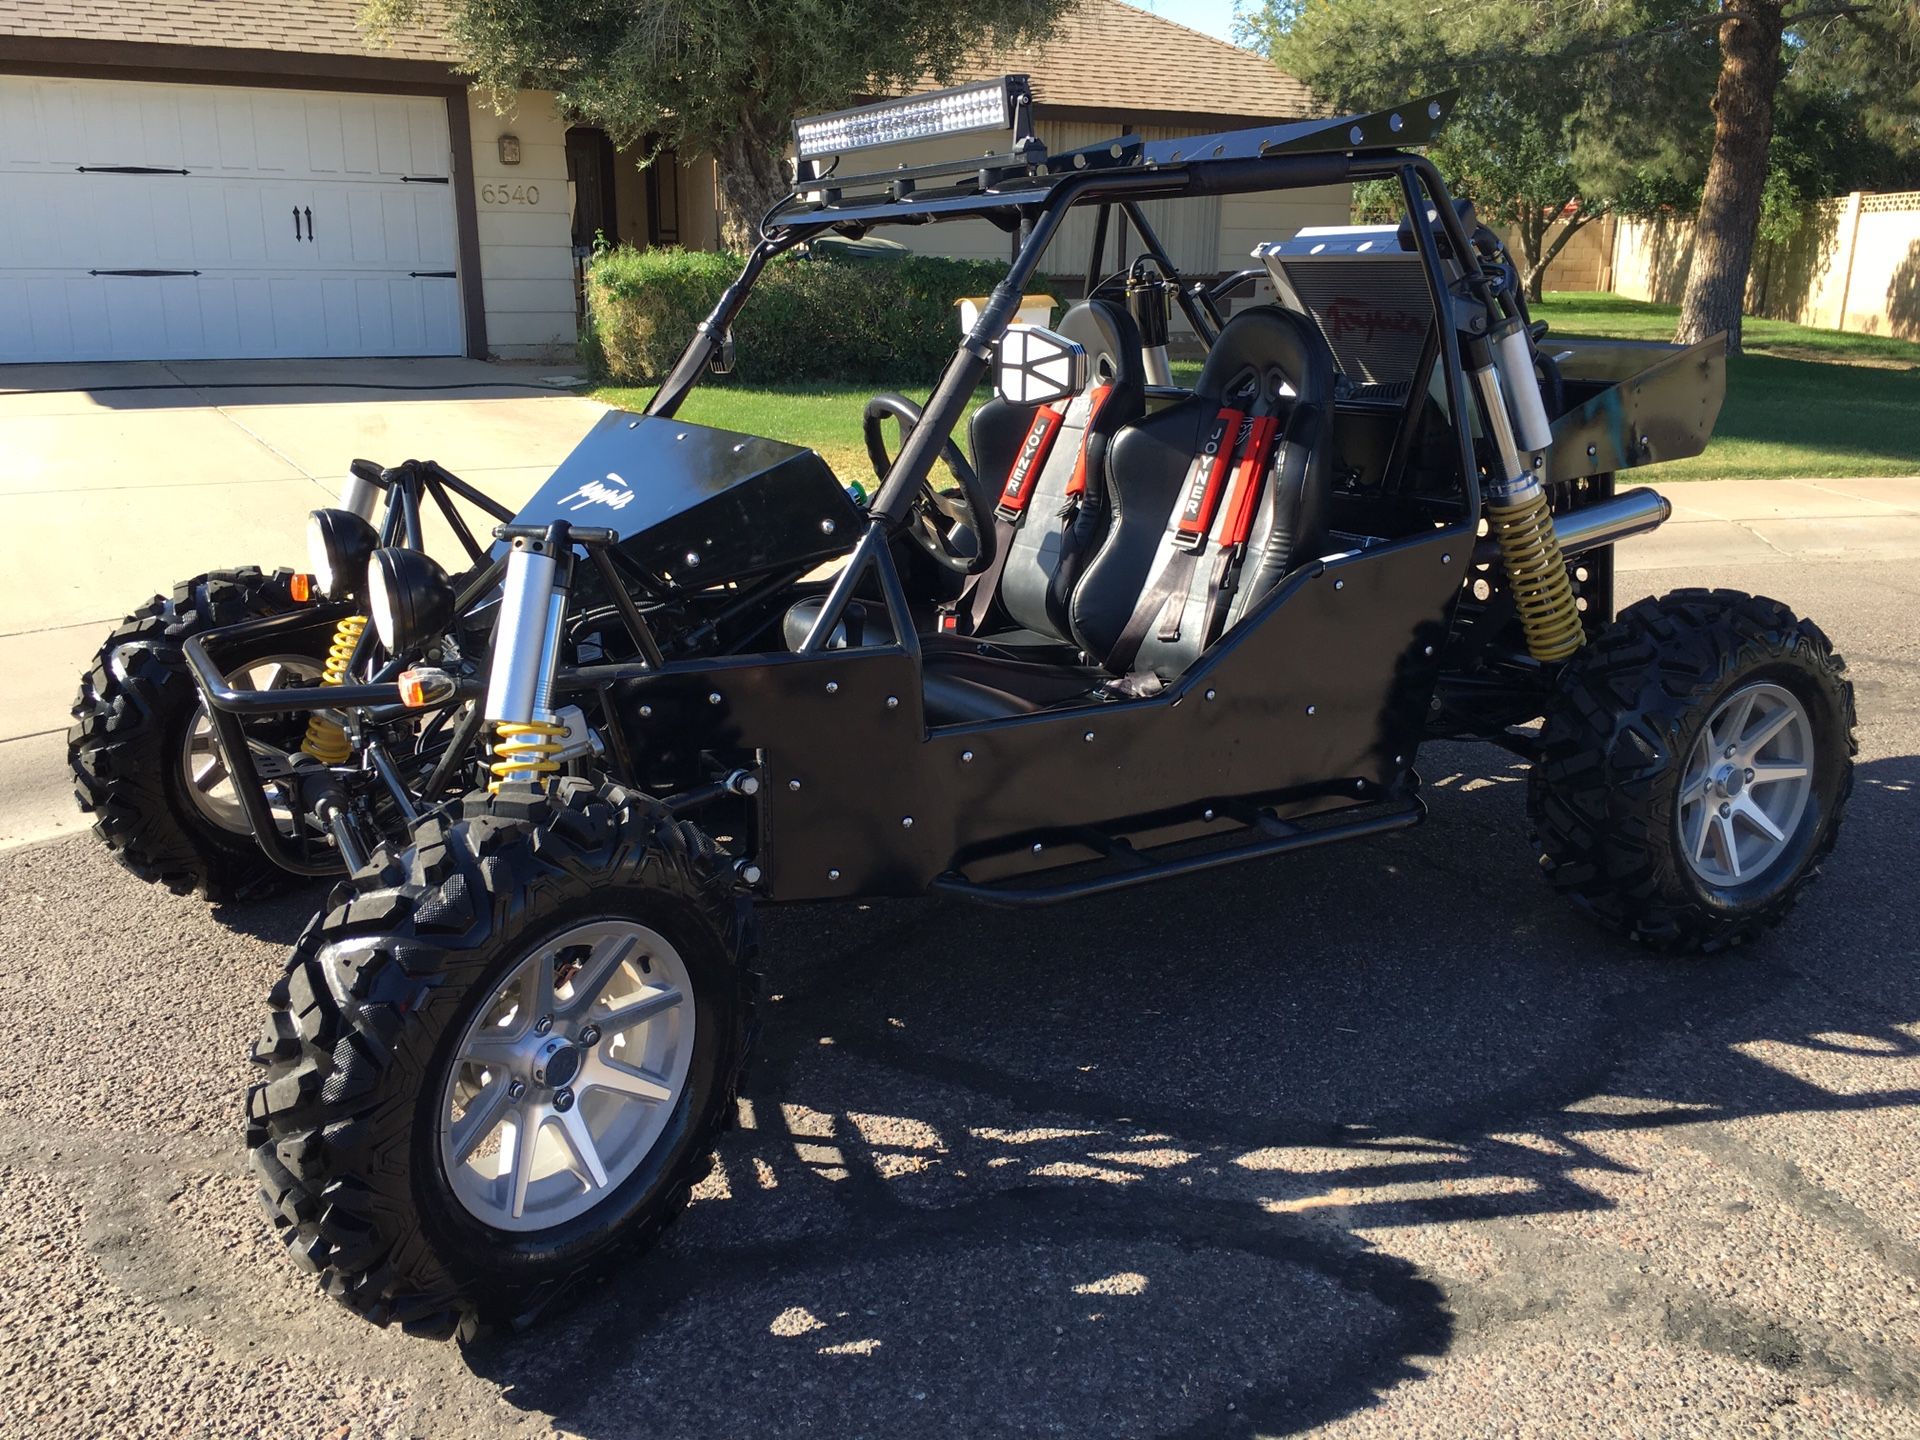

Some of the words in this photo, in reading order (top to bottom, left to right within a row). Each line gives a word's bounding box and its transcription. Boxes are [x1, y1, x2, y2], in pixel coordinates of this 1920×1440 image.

[481, 183, 540, 206] 6540
[1007, 423, 1046, 492] JOYNER
[1185, 427, 1222, 514] JOYNER
